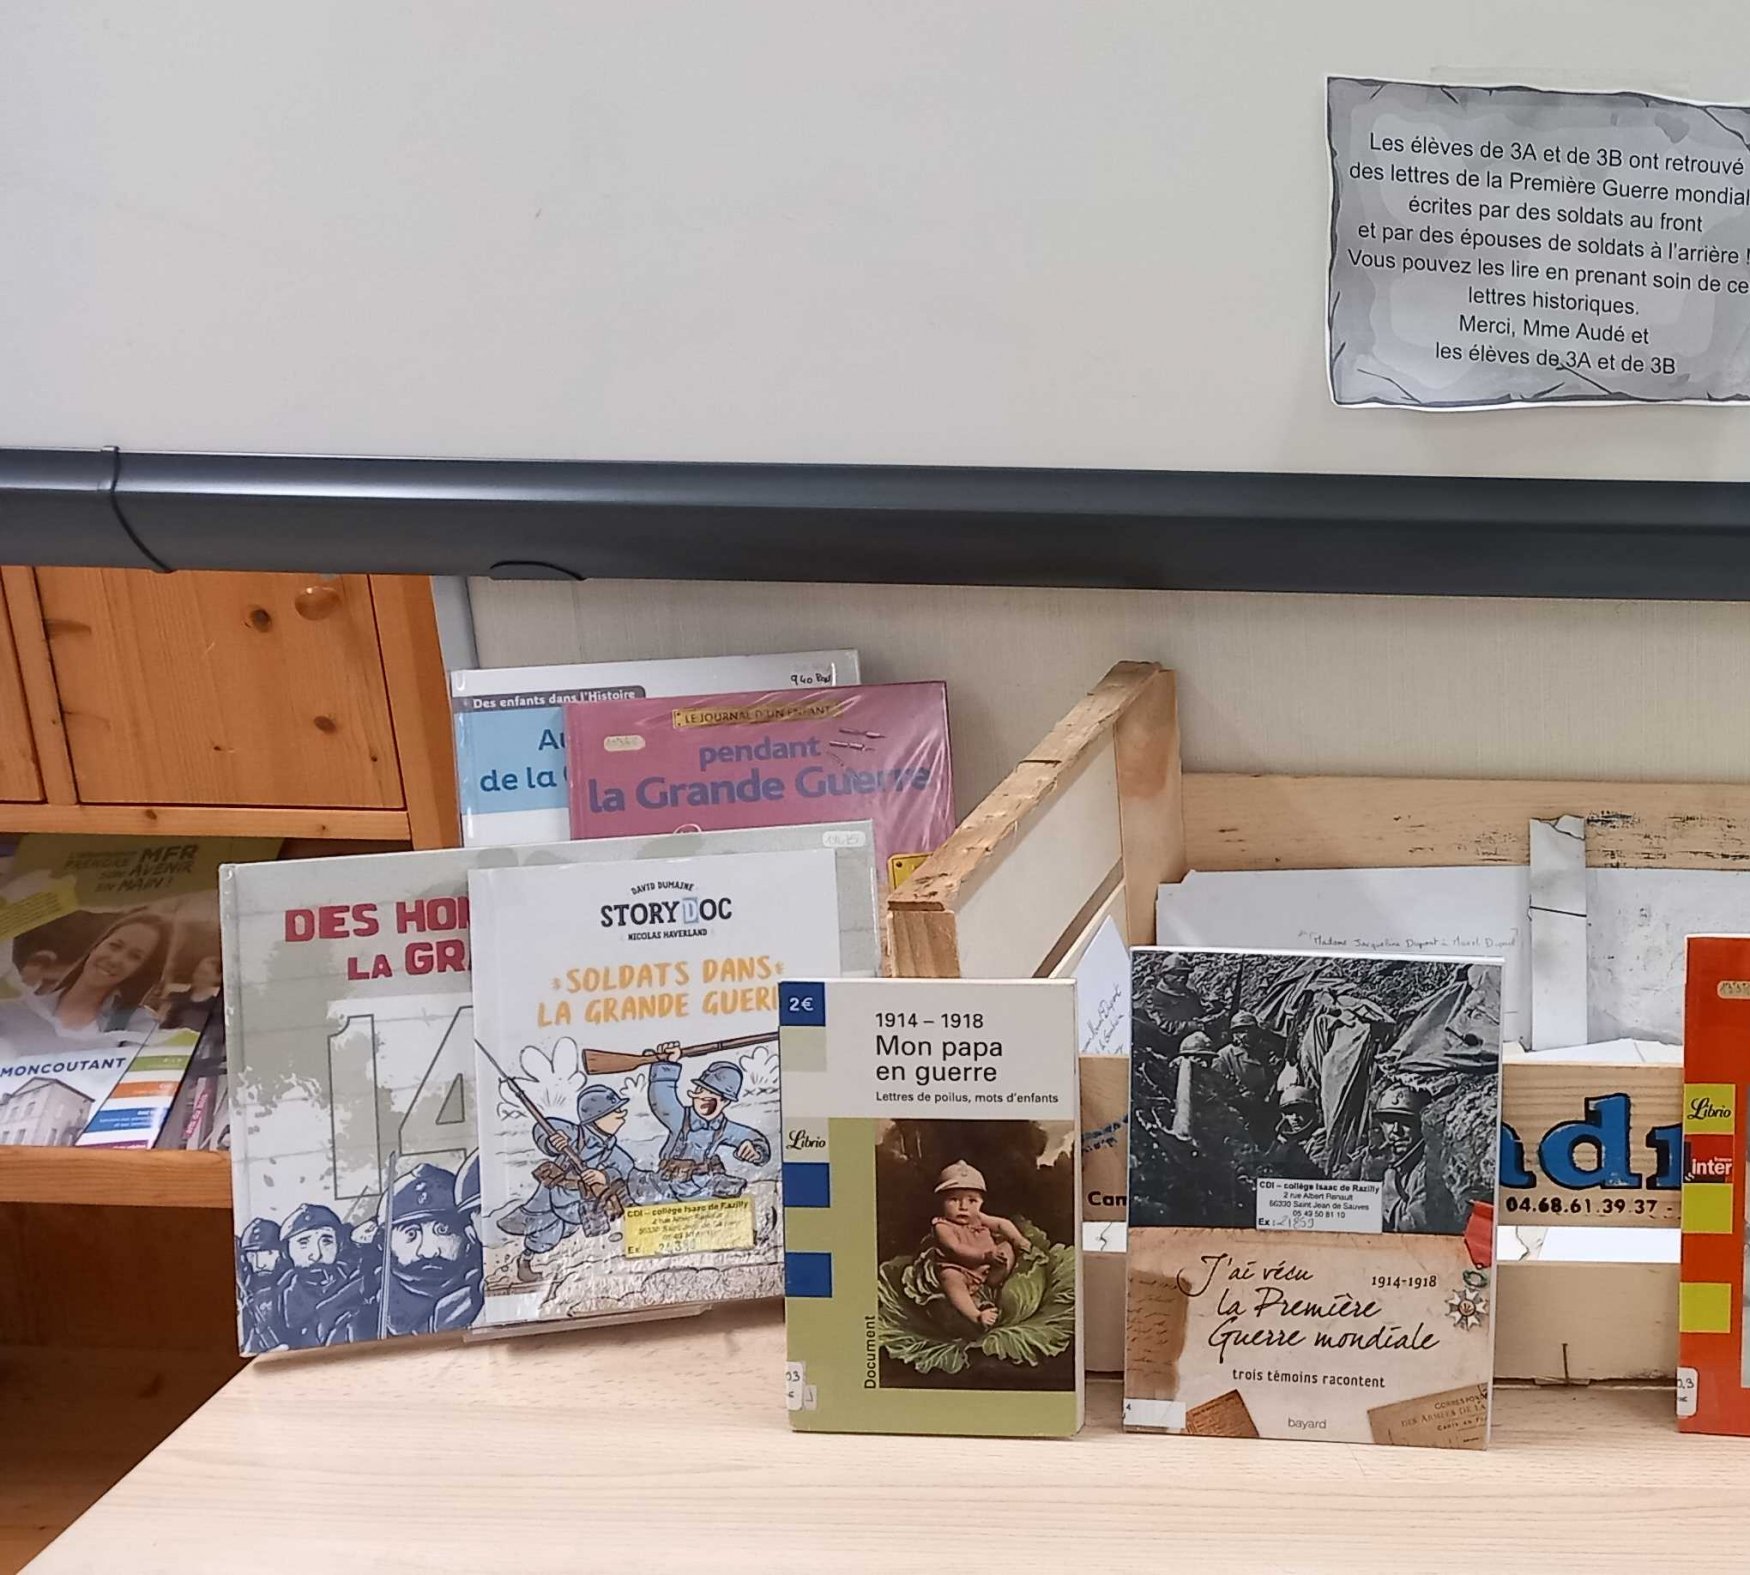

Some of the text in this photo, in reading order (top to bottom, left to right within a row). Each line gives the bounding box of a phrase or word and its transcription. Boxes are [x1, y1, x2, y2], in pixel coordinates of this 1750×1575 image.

[1371, 133, 1743, 175] Les élèves de 3A et de 3B ont retrouvé
[1350, 162, 1383, 180] des
[1391, 164, 1449, 185] lettres
[1457, 169, 1479, 187] de
[1487, 171, 1502, 188] la
[1511, 172, 1595, 195] Première
[1603, 179, 1668, 200] Guerre
[1409, 199, 1702, 232] écrites par des soldats au front
[1359, 223, 1376, 238] et
[1383, 227, 1413, 243] par
[1420, 226, 1453, 244] des
[1461, 232, 1541, 249] épouses
[1549, 234, 1571, 251] de
[1578, 238, 1644, 257] soldats
[1651, 241, 1661, 258] à
[1669, 243, 1738, 263] l'arrière
[1348, 249, 1395, 268] Vous
[1403, 257, 1471, 273] pouvez
[1479, 258, 1504, 275] les
[1512, 260, 1540, 278] lire
[1546, 267, 1568, 280] en
[1576, 269, 1646, 286] prenant
[1653, 272, 1690, 289] soin
[1698, 275, 1720, 292] de
[1469, 286, 1640, 316] lettres historiques.
[1460, 315, 1648, 344] Merci, Mme Audé et
[1436, 342, 1675, 374] les élèves de 3A et de 3B
[473, 687, 636, 710] Des enfants dans l'Histoire
[699, 736, 823, 771] pendant
[480, 767, 557, 792] de la
[589, 766, 932, 813] la Grande Guerre
[631, 881, 694, 895] DAVID DUMAINE
[285, 904, 379, 942] DES
[628, 929, 707, 940] NICOLAS HAVERLAND
[348, 954, 392, 980] LA
[567, 956, 771, 993] SOLDATS DANS
[538, 1001, 571, 1027] LA
[585, 996, 688, 1024] GRANDE
[790, 998, 813, 1011] 2€
[876, 1013, 983, 1028] 1914 1918
[877, 1035, 1002, 1061] Mon papa
[0, 1058, 127, 1078] MONCOUTANT
[877, 1066, 996, 1085] en guerre
[876, 1092, 1058, 1103] Lettres de poilus, mots d'enfants
[1687, 1098, 1731, 1120] Librio
[786, 1130, 825, 1150] Librio
[1693, 1157, 1732, 1175] inter
[1506, 1197, 1657, 1214] 04.68.61.39.37
[1175, 1253, 1313, 1297] J'ai vécu
[1372, 1275, 1436, 1289] 1914-1918
[1217, 1287, 1381, 1318] la Première
[864, 1316, 876, 1388] Document
[1208, 1316, 1439, 1364] Guerre mondiale
[1233, 1369, 1385, 1388] trois témoins racontent
[1288, 1418, 1326, 1430] bayard
